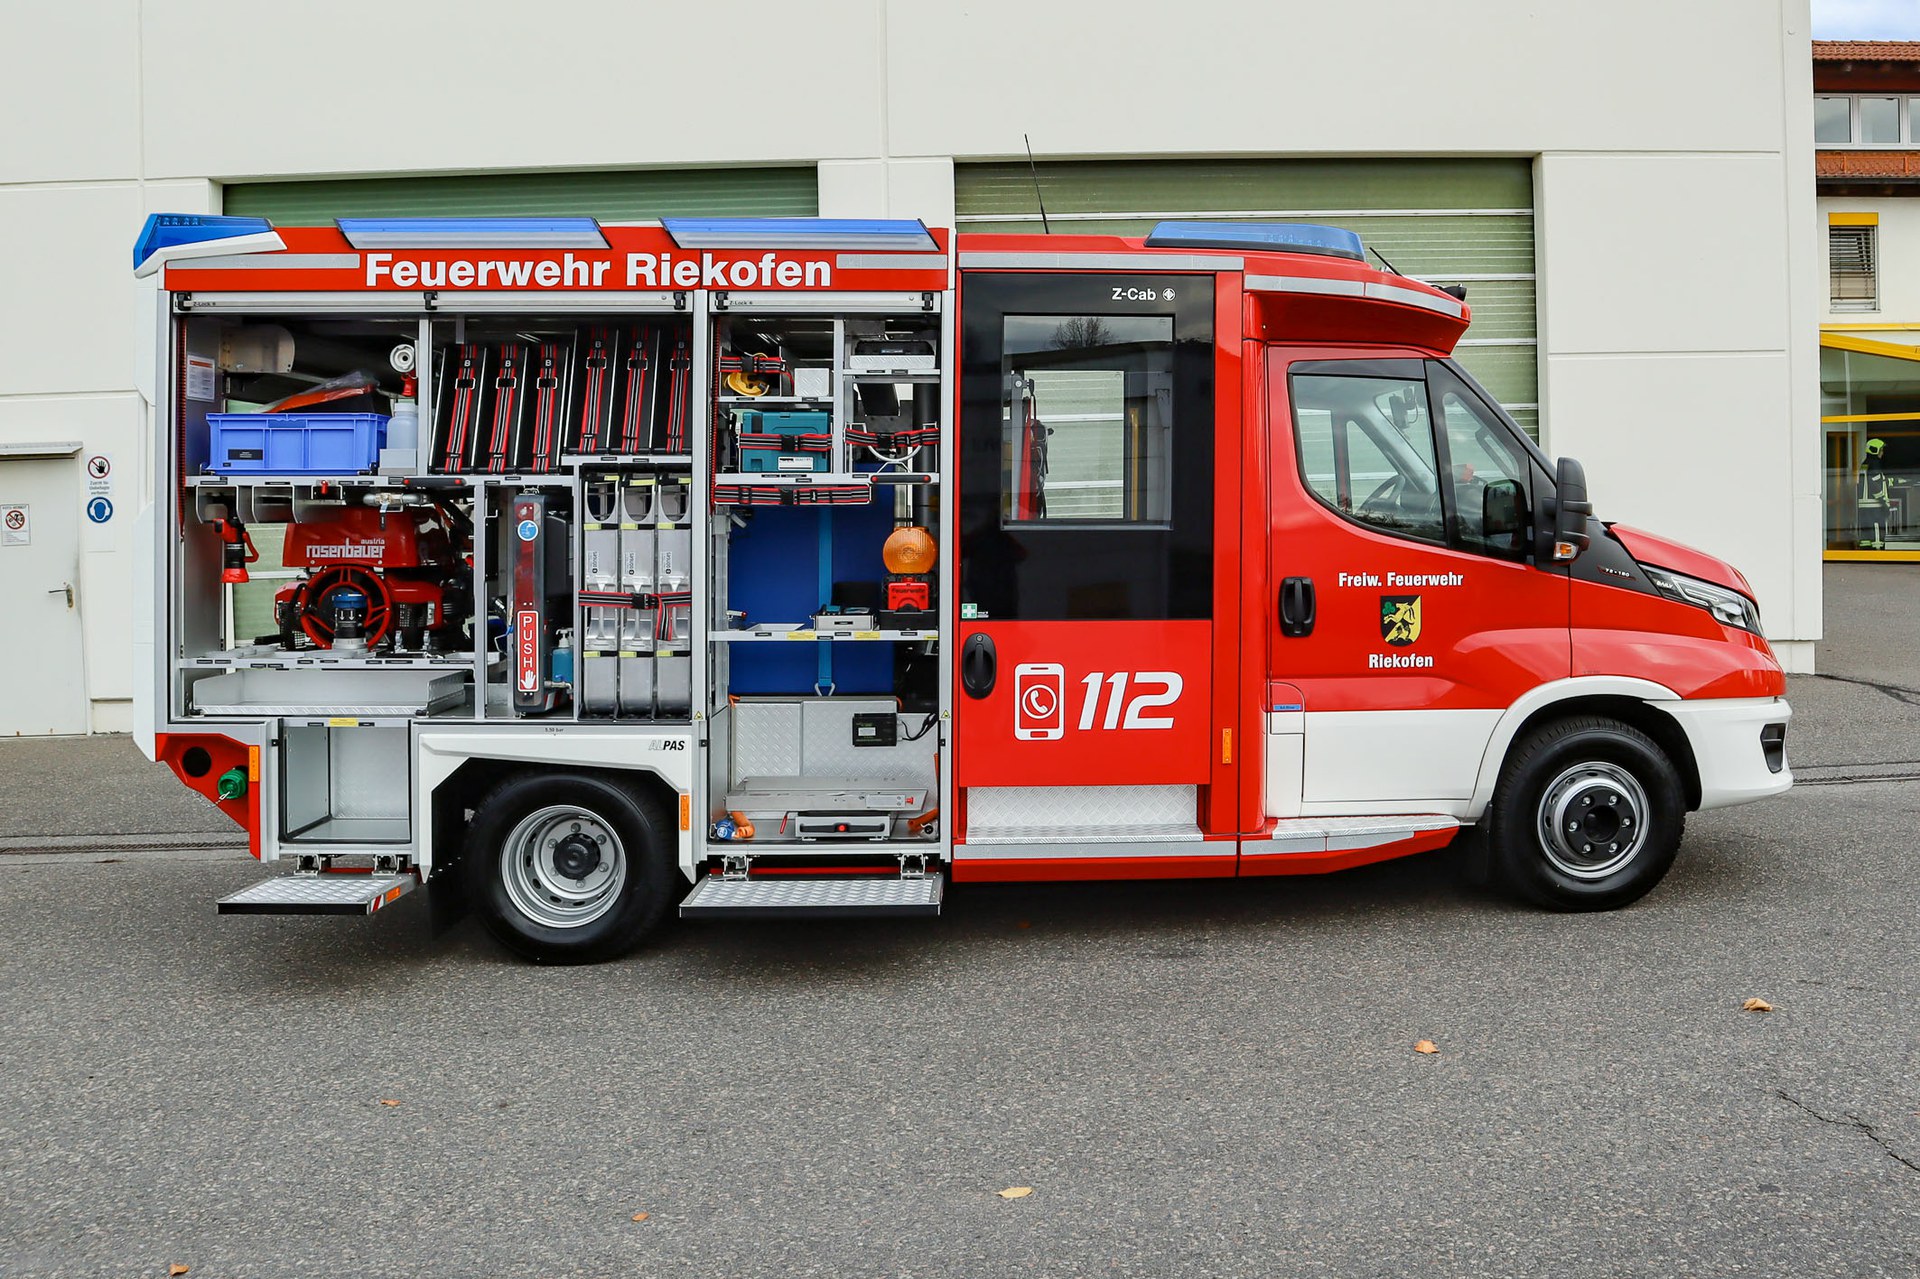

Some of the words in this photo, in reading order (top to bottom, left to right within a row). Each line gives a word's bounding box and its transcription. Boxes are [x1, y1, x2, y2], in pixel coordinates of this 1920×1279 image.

[366, 253, 611, 287] Feuerwehr
[626, 253, 831, 287] Riekofen
[1111, 287, 1157, 301] Z-Cab
[594, 340, 602, 349] B
[636, 341, 643, 349] B
[678, 341, 685, 349] B
[464, 359, 472, 367] B
[505, 360, 512, 368] B
[545, 359, 553, 367] B
[306, 537, 386, 559] rosenbauer
[1338, 572, 1382, 587] Freiw.
[1387, 571, 1464, 586] Feuerwehr
[523, 615, 533, 668] PUSH
[1368, 653, 1434, 669] Riekofen
[1078, 671, 1184, 730] 112
